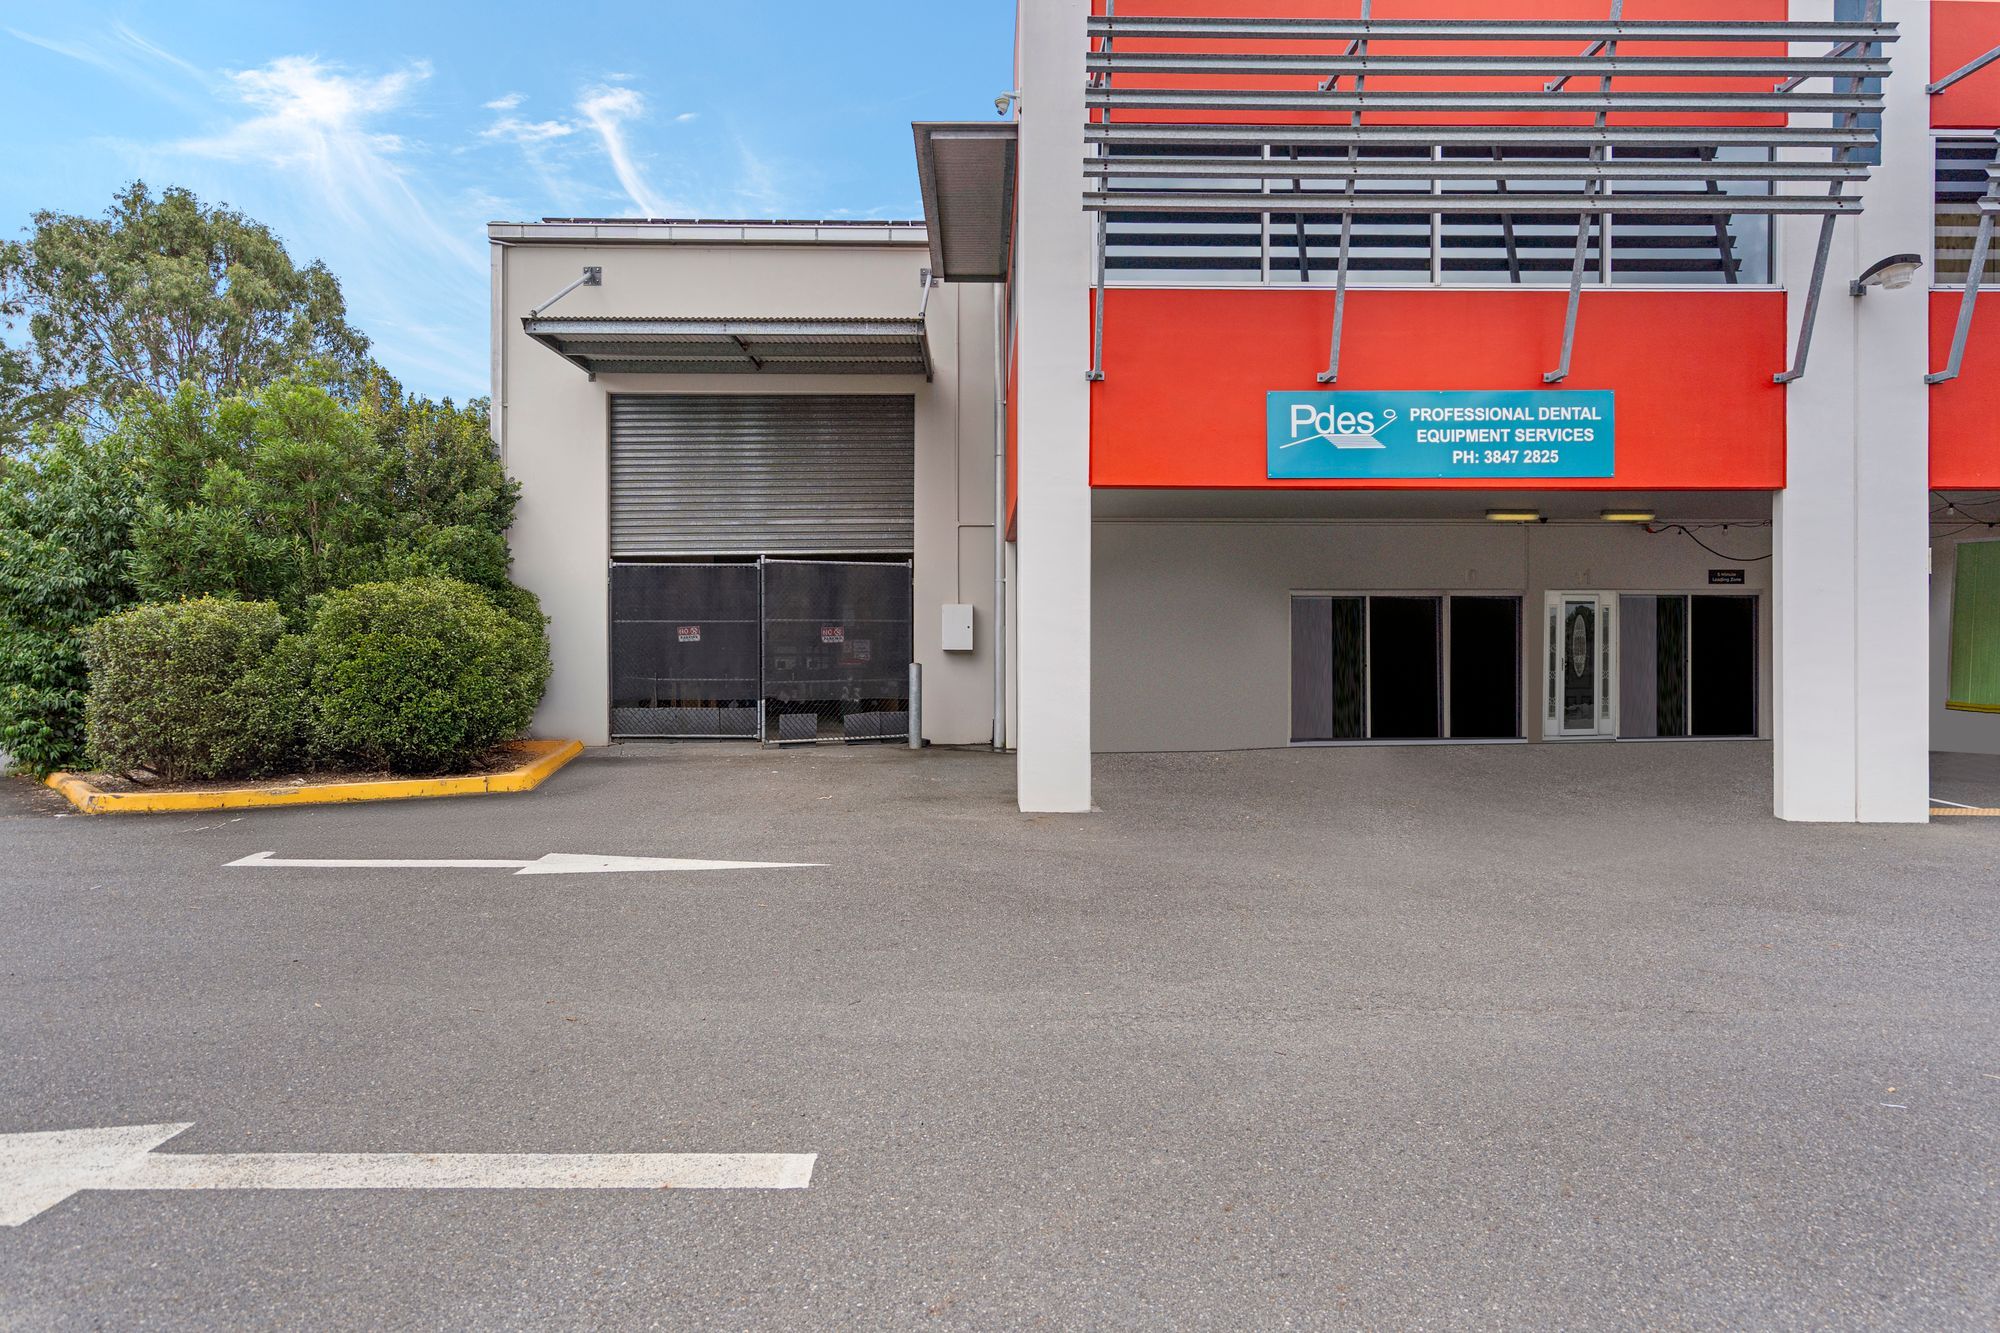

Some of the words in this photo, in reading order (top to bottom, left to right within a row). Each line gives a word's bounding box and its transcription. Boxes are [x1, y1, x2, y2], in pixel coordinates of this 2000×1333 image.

[1290, 404, 1374, 438] Pdes
[1409, 407, 1534, 421] PROFESSIONAL
[1538, 407, 1601, 421] DENTAL
[1416, 429, 1510, 443] EQUIPMENT
[1514, 428, 1594, 442] SERVICES
[1453, 450, 1479, 464] PH:
[1484, 450, 1518, 463] 3847
[1523, 450, 1559, 463] 2825
